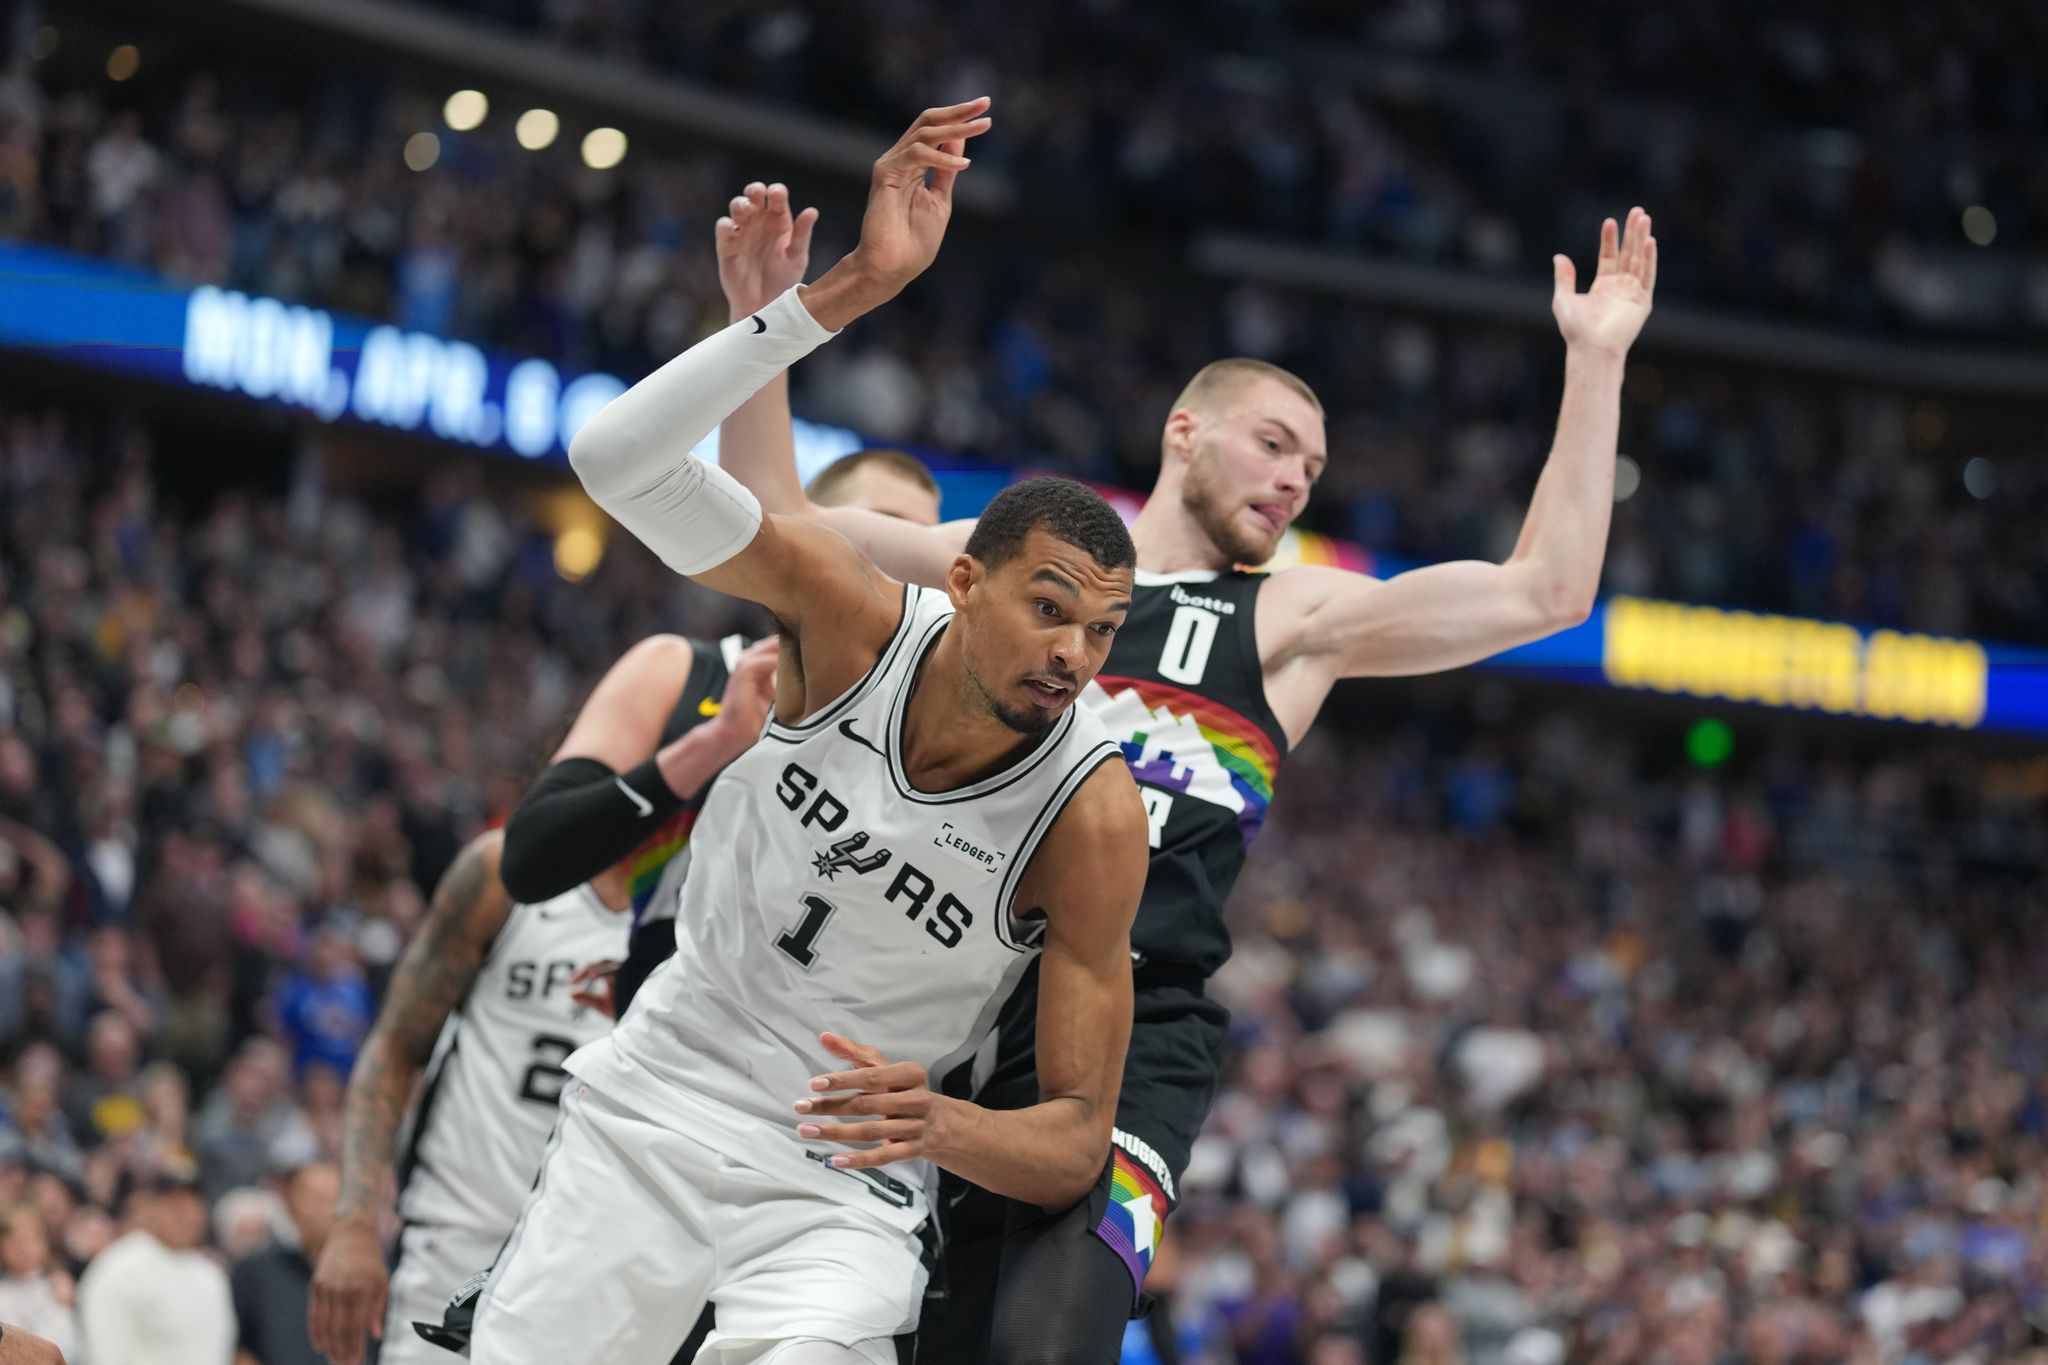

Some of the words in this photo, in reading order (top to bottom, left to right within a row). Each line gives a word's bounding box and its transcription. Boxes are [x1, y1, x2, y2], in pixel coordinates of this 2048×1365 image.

[1170, 583, 1236, 615] ibotta
[1157, 606, 1220, 685] 0
[776, 762, 973, 949] SPURS
[945, 832, 995, 867] LEDGER
[772, 891, 838, 971] 1
